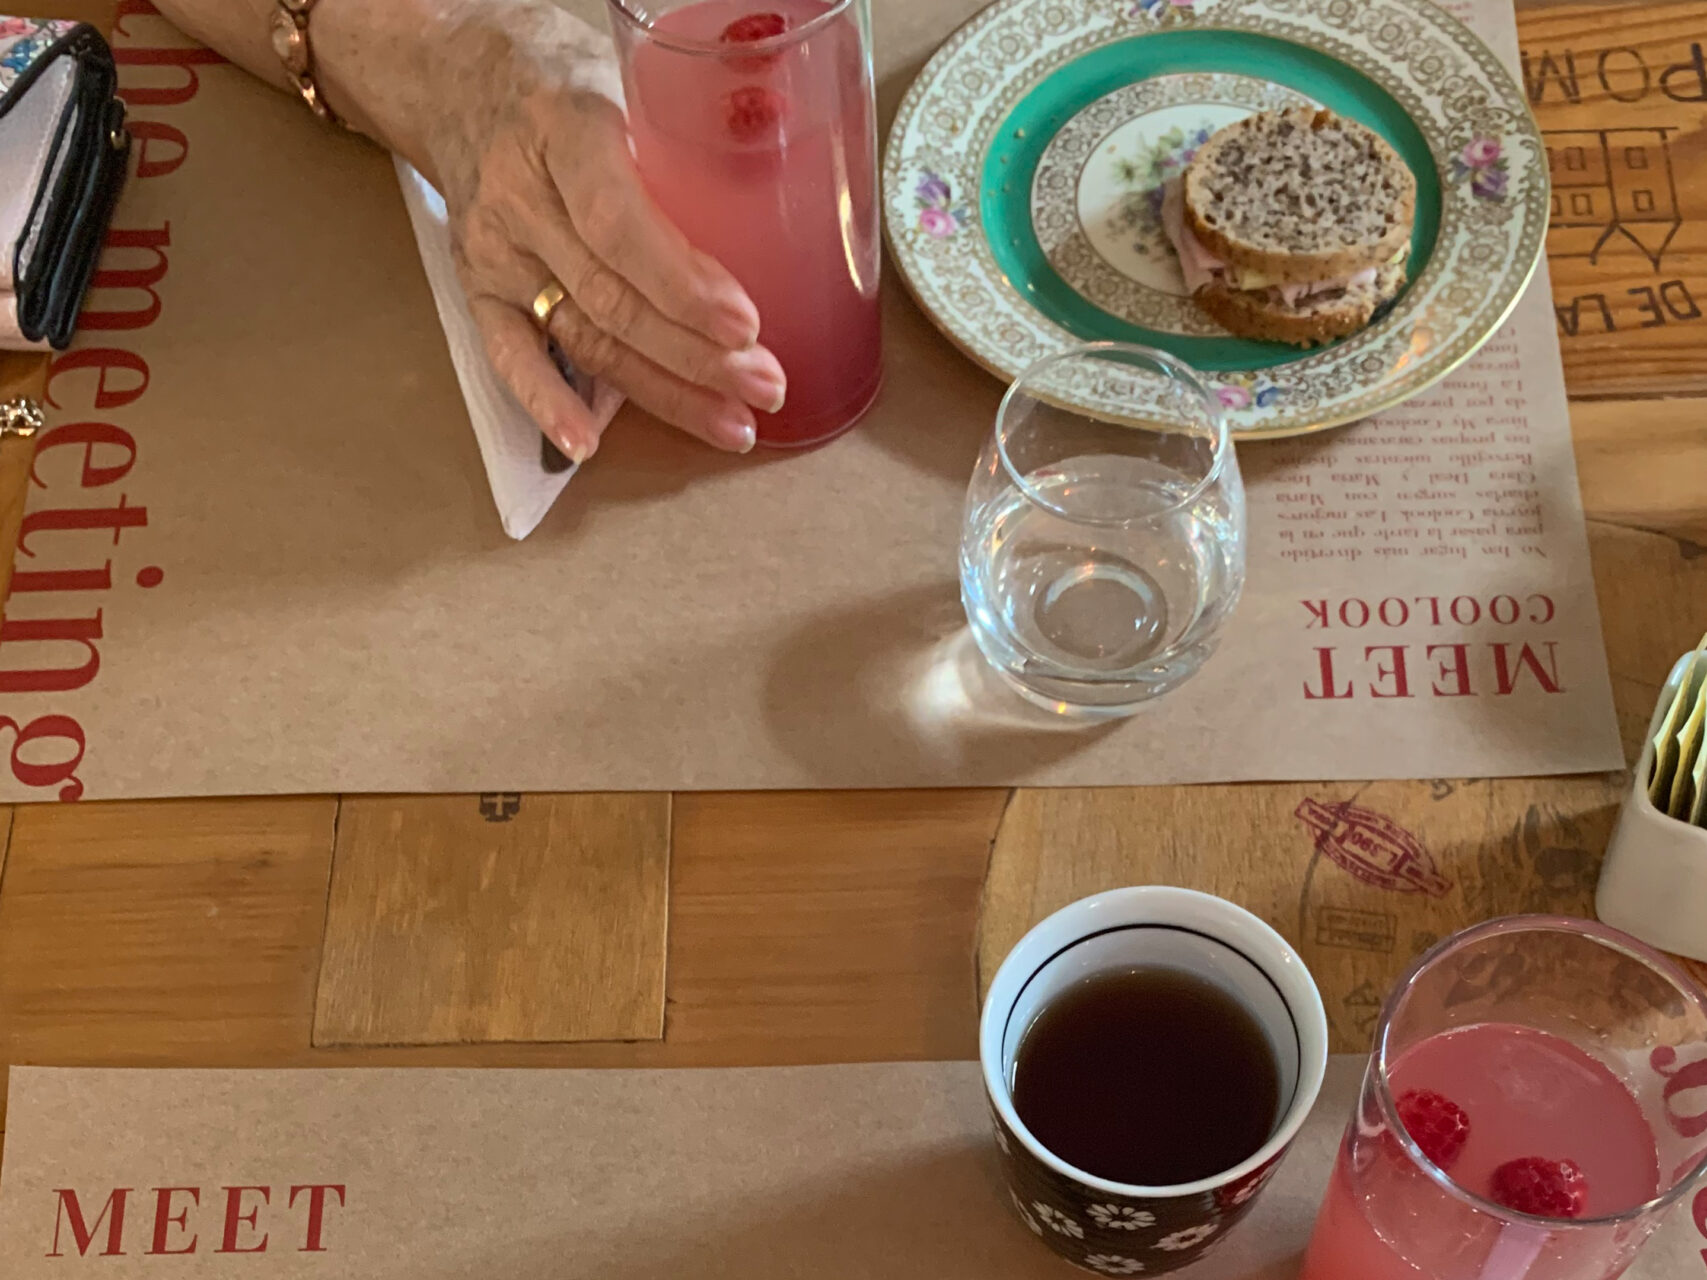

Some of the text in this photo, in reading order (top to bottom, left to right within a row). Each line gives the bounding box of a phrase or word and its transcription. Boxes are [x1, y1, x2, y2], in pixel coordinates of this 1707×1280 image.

[1627, 280, 1702, 329] DE
[0, 221, 170, 801] meeting
[1506, 523, 1544, 537] para
[1280, 546, 1362, 562] divertido
[1374, 547, 1409, 559] más
[1420, 546, 1467, 559] lugar
[1297, 593, 1555, 629] COOLOOK
[1303, 641, 1565, 699] MEET
[46, 1186, 346, 1257] MEET
